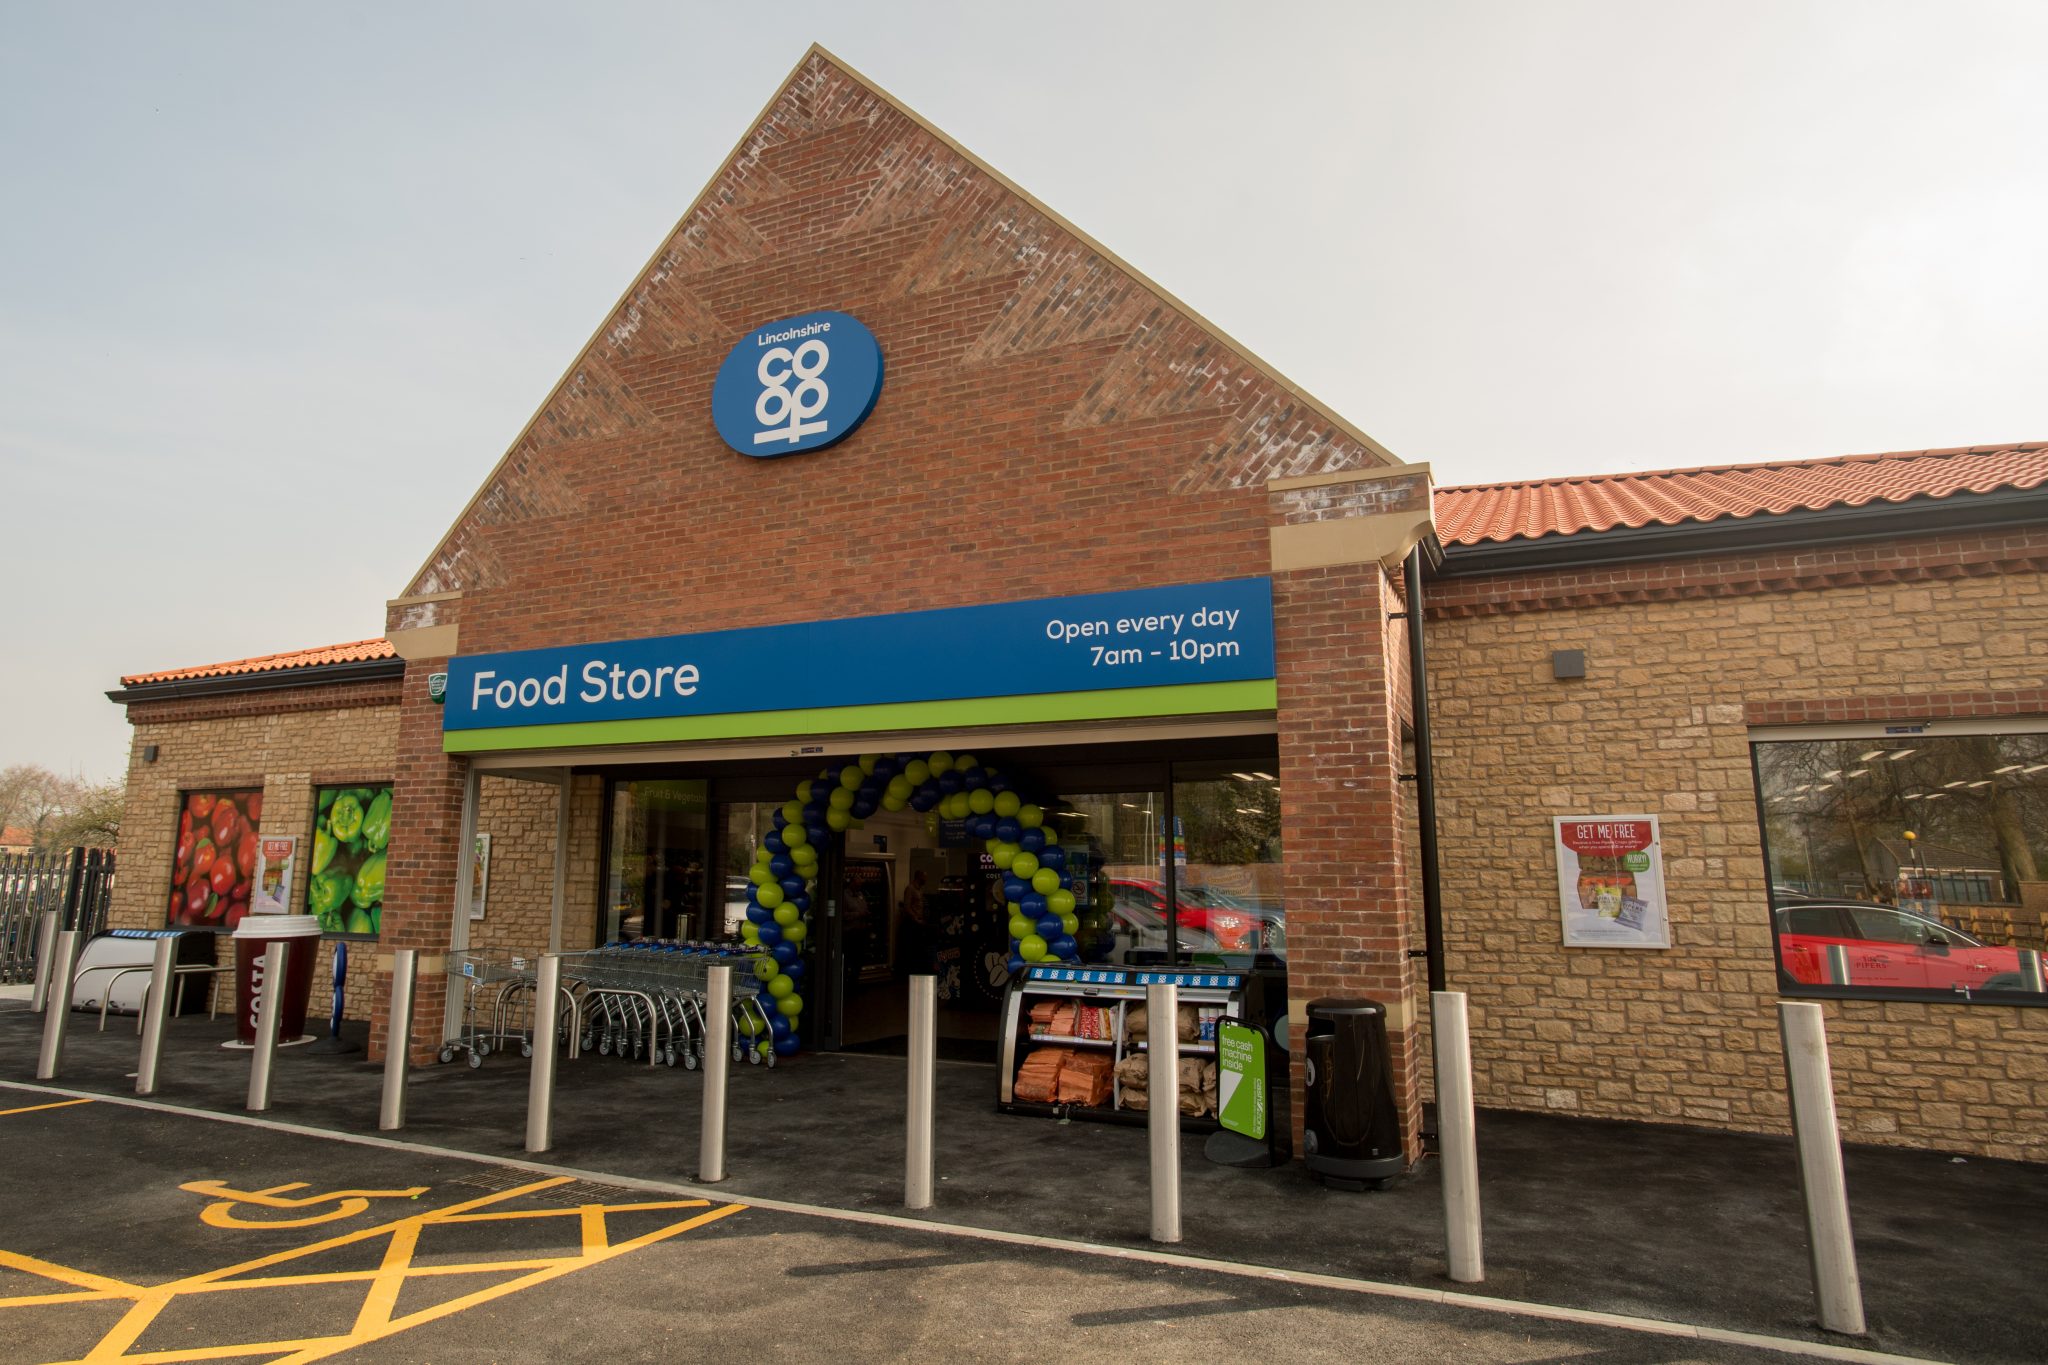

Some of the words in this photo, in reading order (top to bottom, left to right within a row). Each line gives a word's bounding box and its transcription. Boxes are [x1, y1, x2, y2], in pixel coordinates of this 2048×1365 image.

[758, 322, 831, 346] Lincolnshire
[1046, 619, 1109, 644] Open
[1116, 613, 1185, 635] every
[1191, 606, 1240, 631] day
[1090, 646, 1142, 667] 7am
[1169, 639, 1240, 664] 10pm
[472, 664, 568, 711] Food
[579, 660, 700, 704] Store
[644, 786, 663, 800] Fruit
[1577, 825, 1594, 839] GET
[1598, 824, 1611, 838] ME
[1614, 823, 1636, 838] FREE
[1222, 1035, 1235, 1048] free
[1236, 1040, 1253, 1052] cash
[1222, 1048, 1252, 1063] machine
[1222, 1056, 1244, 1071] inside
